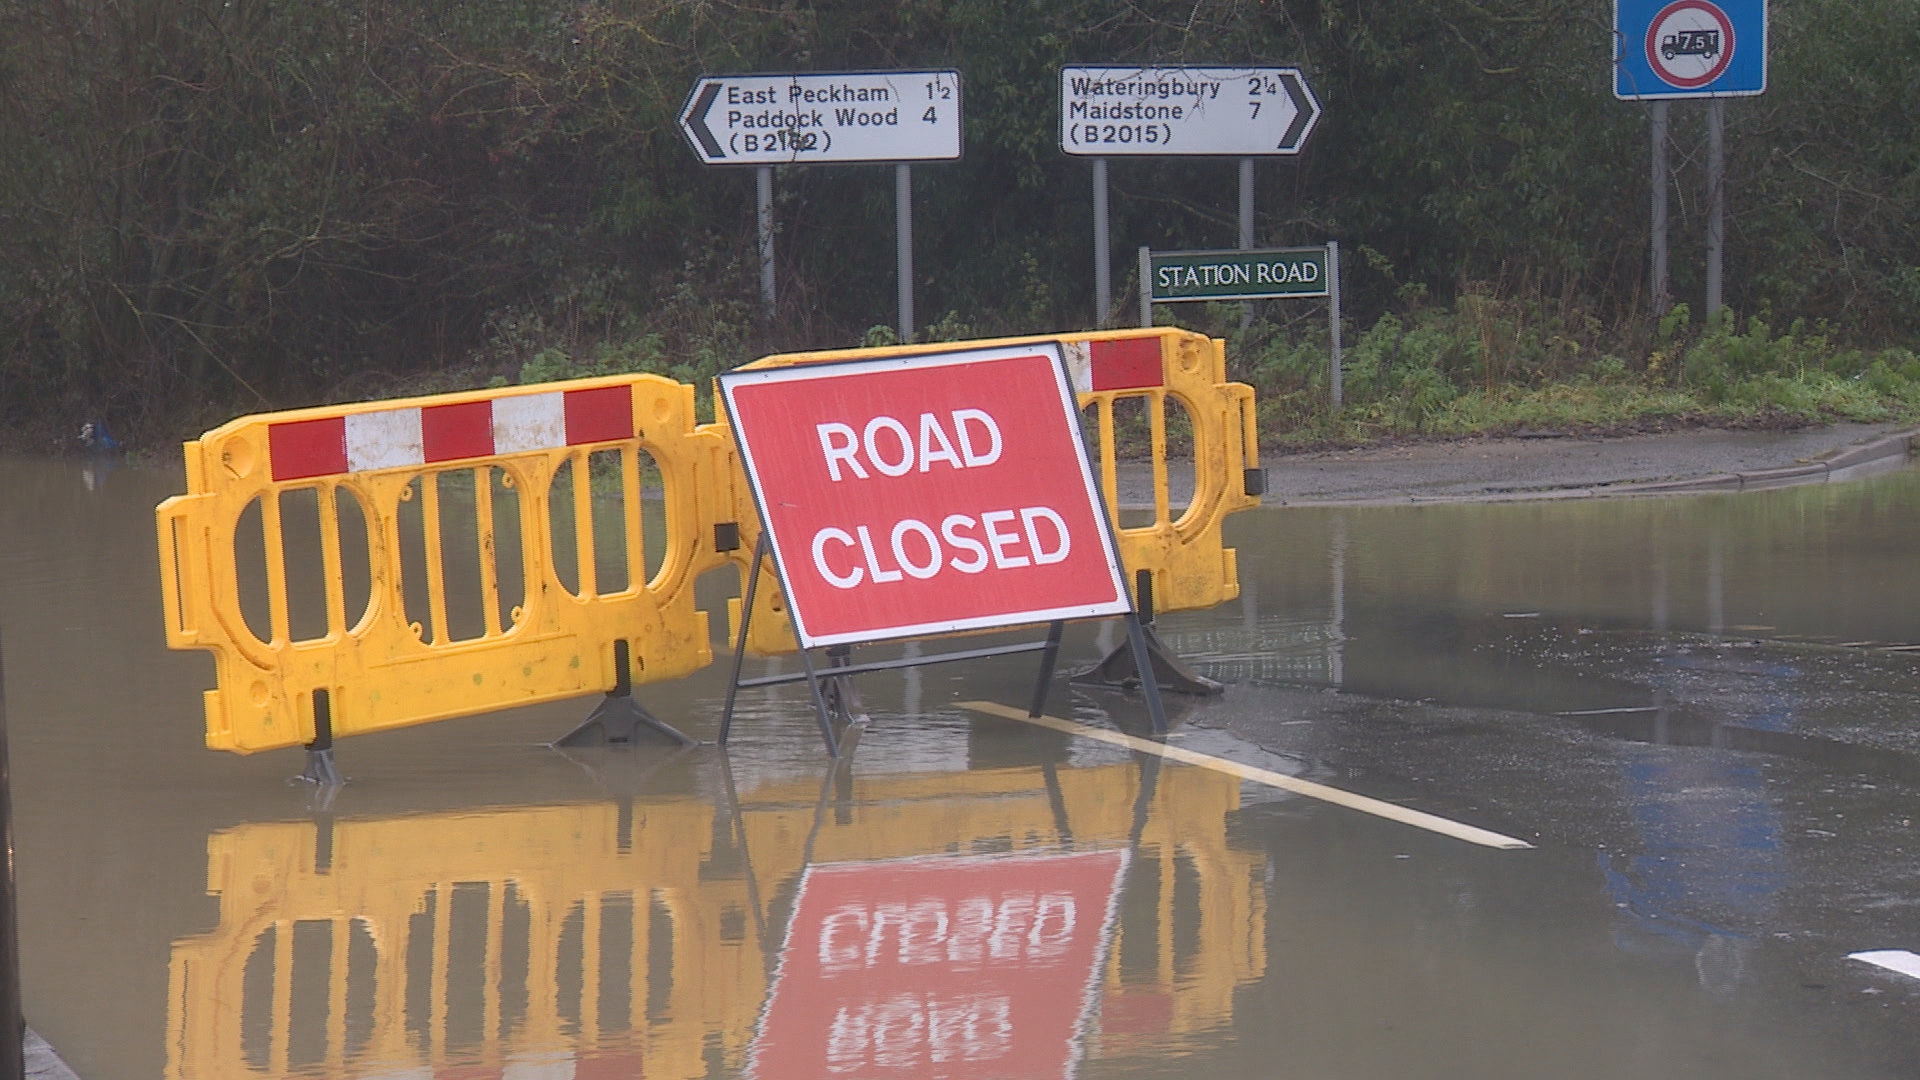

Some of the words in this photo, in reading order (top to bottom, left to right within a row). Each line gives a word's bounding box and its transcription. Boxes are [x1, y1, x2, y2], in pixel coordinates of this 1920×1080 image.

[727, 86, 777, 105] East
[788, 83, 890, 104] Peckham
[1070, 76, 1221, 99] Wateringbury
[727, 108, 824, 129] Paddock
[835, 106, 899, 127] Wood
[921, 105, 938, 125] 4
[1069, 100, 1184, 120] Maidstone
[1248, 101, 1262, 120] 7
[1069, 122, 1172, 146] (B2015)
[1158, 263, 1251, 288] STATION
[1256, 261, 1319, 285] ROAD
[816, 408, 1003, 482] ROAD
[811, 506, 1071, 589] CLOSED
